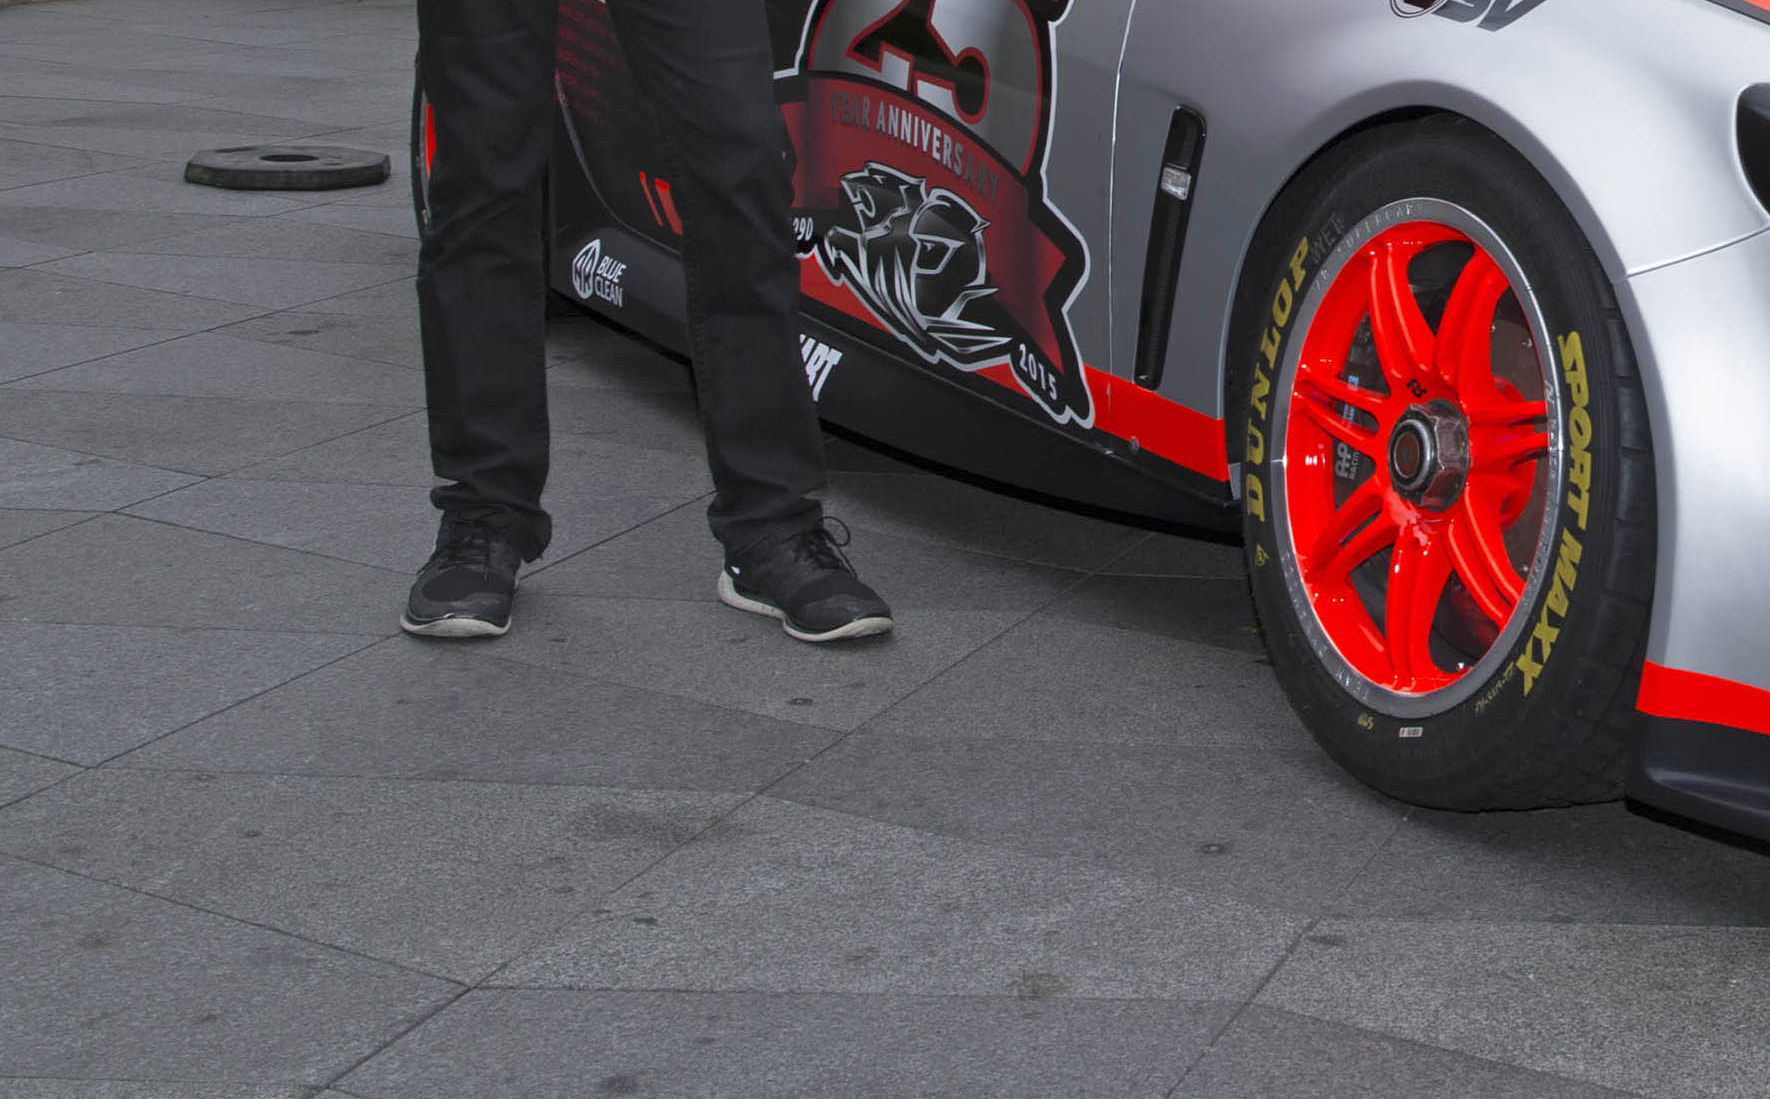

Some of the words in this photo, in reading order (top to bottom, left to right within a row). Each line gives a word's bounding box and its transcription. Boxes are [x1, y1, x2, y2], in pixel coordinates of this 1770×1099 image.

[829, 91, 871, 128] YEAR
[875, 102, 1000, 198] ANNIVERSARY
[594, 276, 623, 308] CLEAN
[596, 255, 627, 283] BLUE
[1018, 343, 1059, 400] 2015
[1245, 236, 1309, 522] DUNLOP
[1349, 450, 1361, 480] RACIN
[1557, 331, 1592, 529] SPORT
[1514, 533, 1584, 697] MAXX
